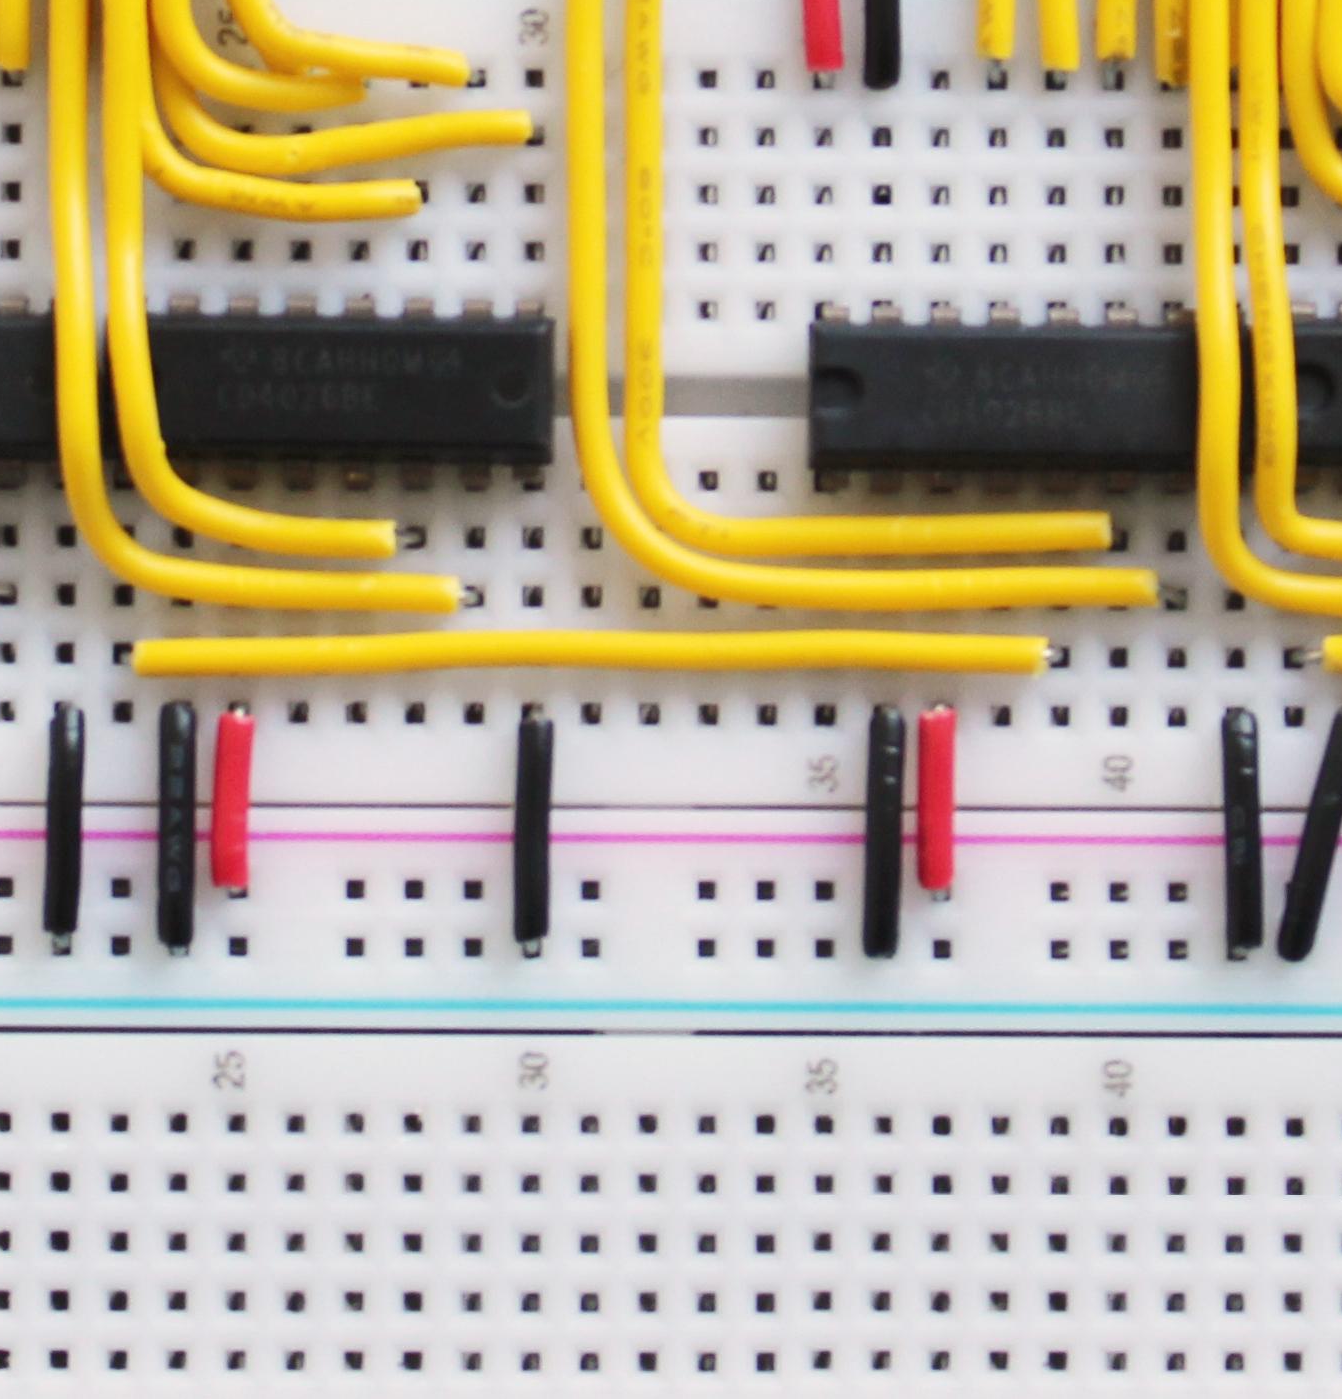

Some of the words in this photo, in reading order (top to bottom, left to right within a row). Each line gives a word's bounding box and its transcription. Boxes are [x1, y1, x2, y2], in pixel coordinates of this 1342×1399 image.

[520, 8, 550, 45] 30
[808, 755, 842, 795] 35
[1101, 755, 1133, 793] 40
[210, 1050, 246, 1090] 25
[518, 1051, 549, 1090] 30
[804, 1058, 838, 1096] 35
[1102, 1059, 1133, 1100] 40
